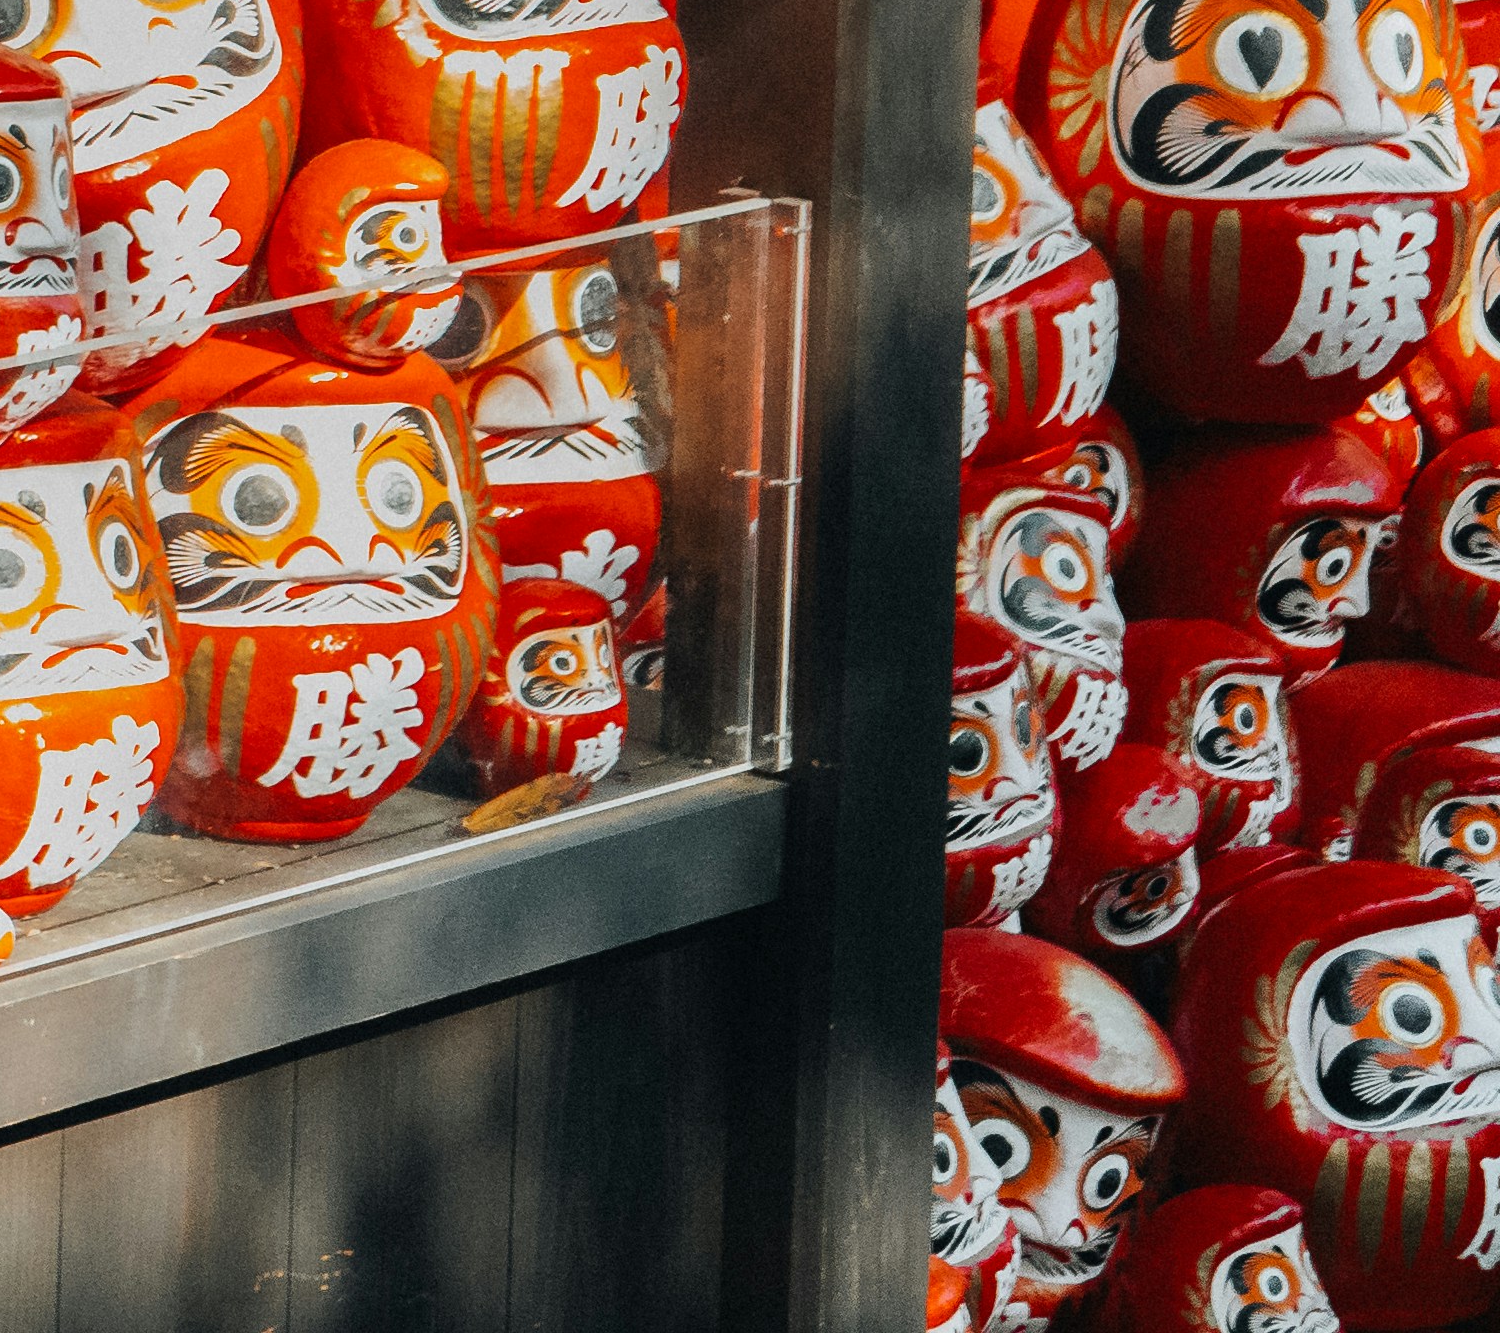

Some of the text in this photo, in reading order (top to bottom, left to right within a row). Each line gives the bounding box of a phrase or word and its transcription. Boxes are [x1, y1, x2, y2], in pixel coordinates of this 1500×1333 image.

[558, 45, 684, 209] 勝
[83, 169, 250, 357] 勝
[1259, 207, 1437, 379] 勝
[1038, 278, 1119, 427] 勝
[257, 646, 425, 800] 勝
[571, 722, 624, 779] 勝
[1048, 673, 1128, 773] 勝
